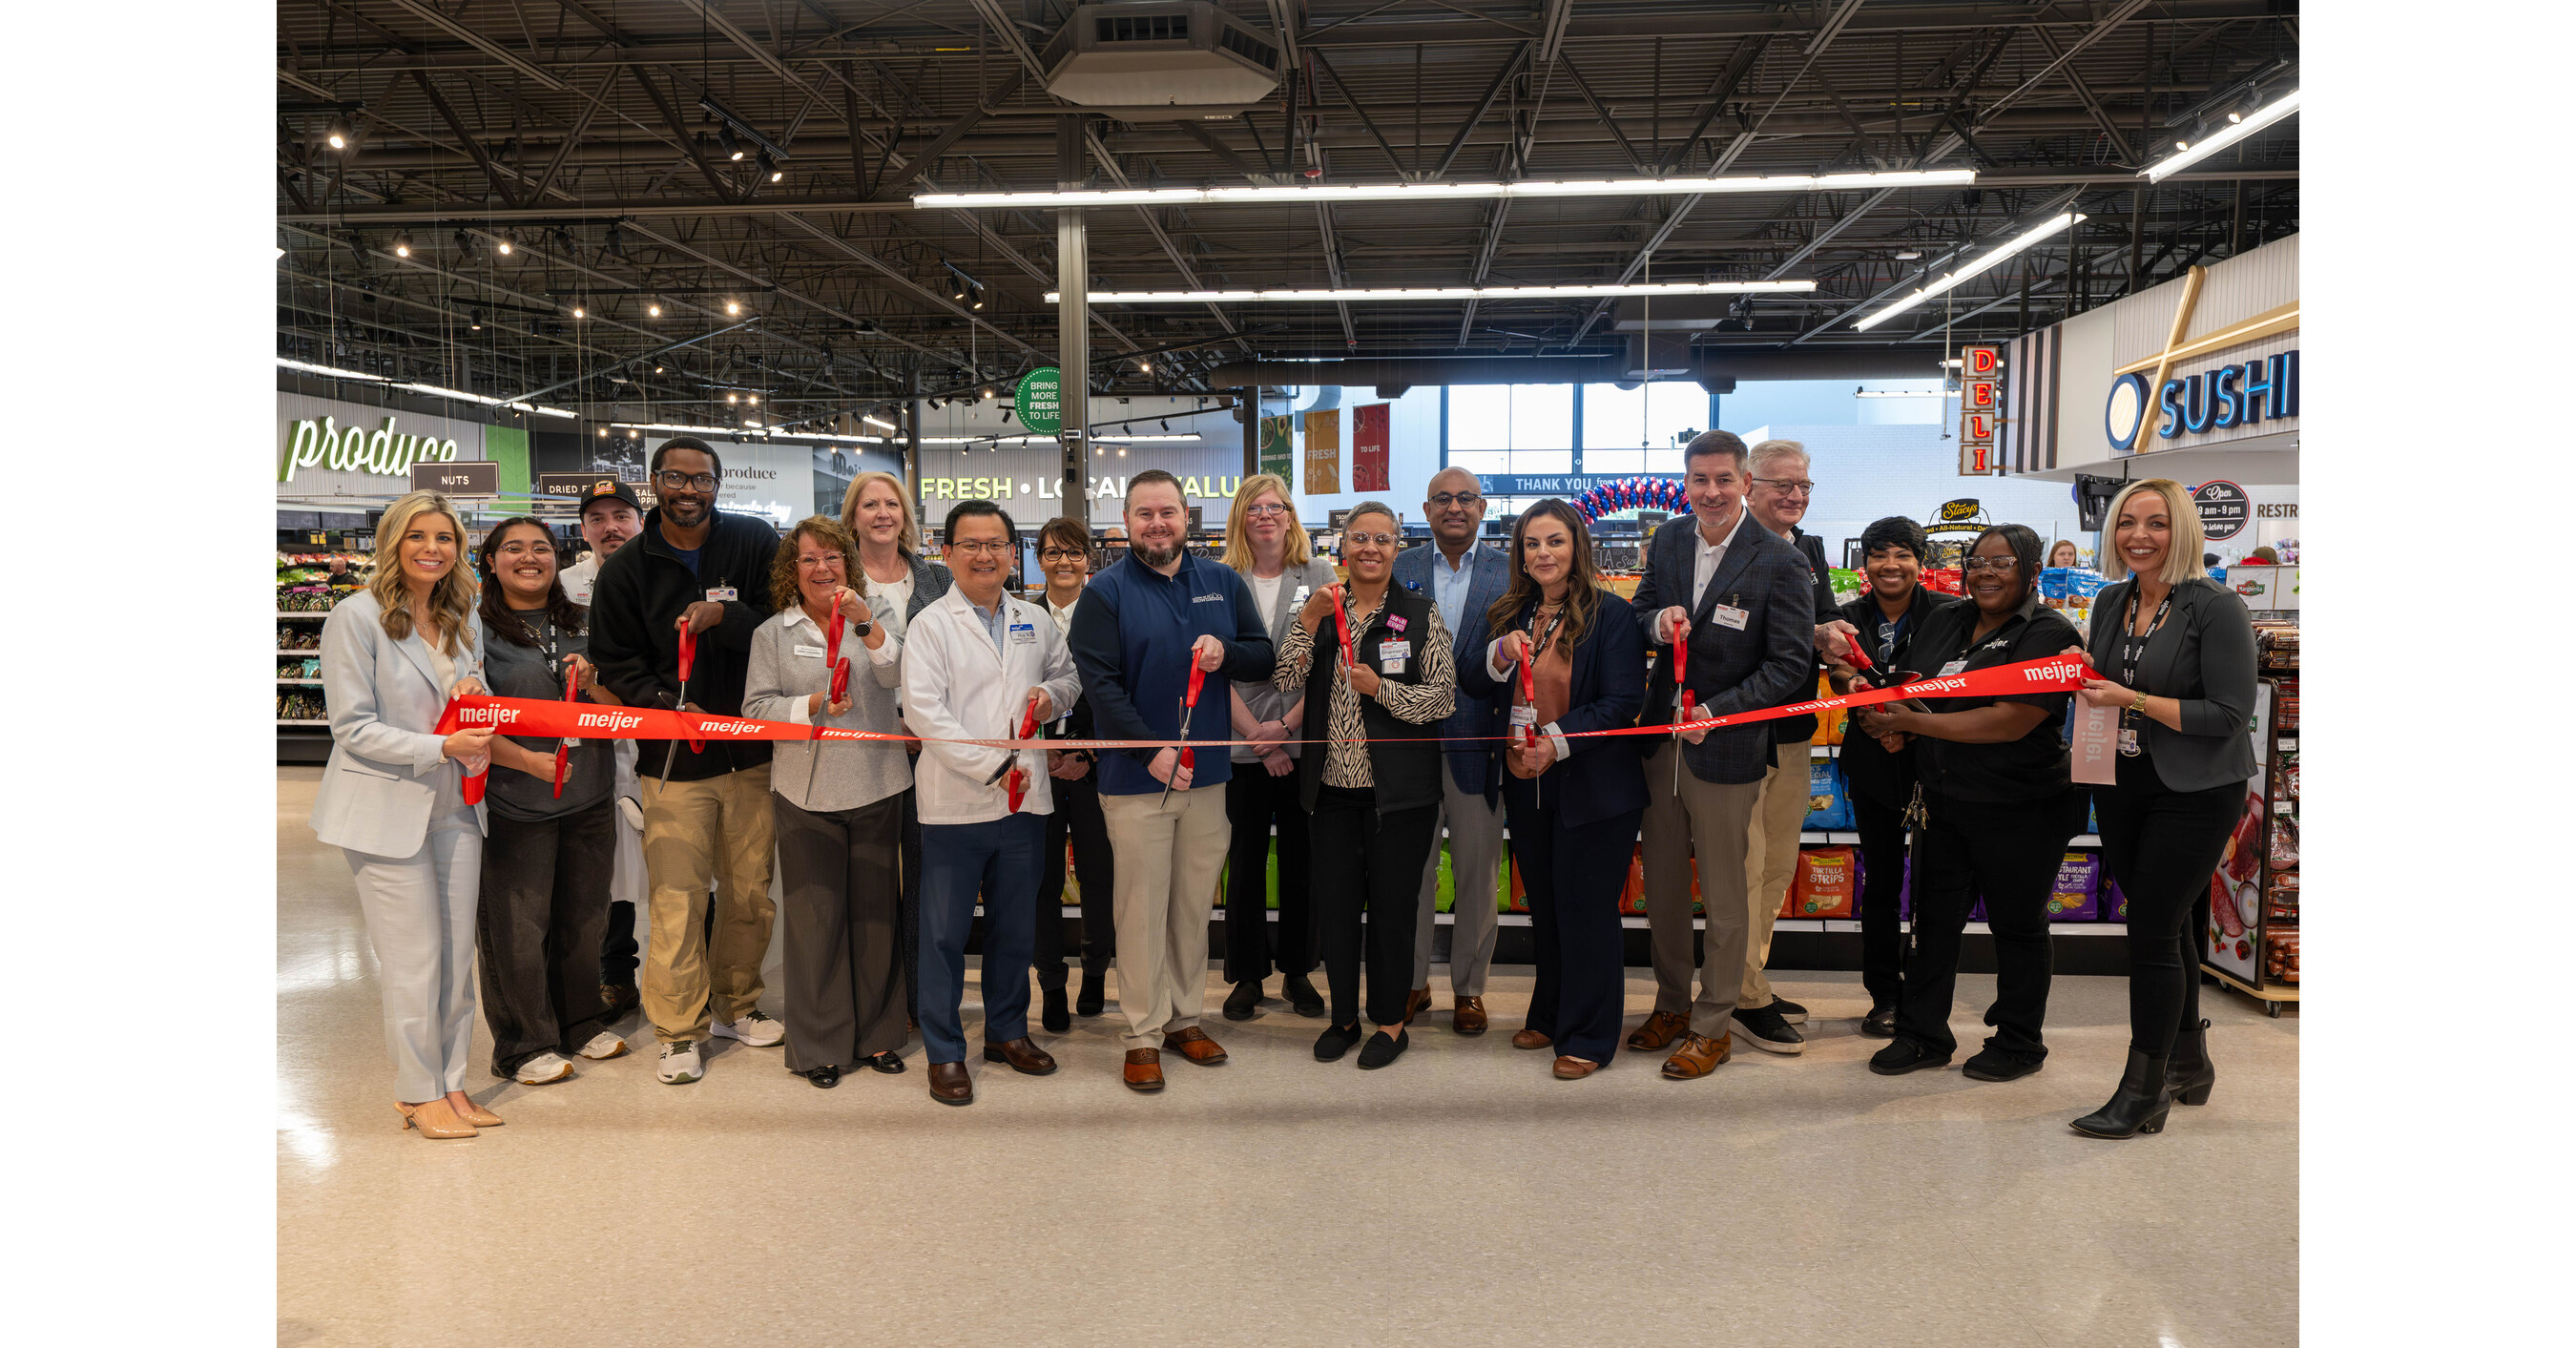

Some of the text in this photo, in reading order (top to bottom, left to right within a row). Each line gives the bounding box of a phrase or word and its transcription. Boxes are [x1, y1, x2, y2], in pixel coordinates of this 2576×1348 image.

[1030, 382, 1058, 390] BRING
[2159, 350, 2299, 439] SUSHI
[1029, 402, 1059, 410] FRESH
[1972, 349, 1995, 470] DELI
[1042, 411, 1060, 420] LIFE
[280, 415, 458, 482] produce
[1307, 447, 1337, 460] FRESH
[441, 475, 470, 486] NUTS
[719, 466, 778, 481] produce
[549, 485, 578, 494] DRIED
[921, 477, 1012, 500] FRESH
[1515, 478, 1561, 490] THANK
[1565, 478, 1591, 490] YOU
[2206, 485, 2233, 501] Open
[1942, 502, 1979, 520] Stacy's
[2197, 506, 2203, 515] 9
[2229, 506, 2241, 516] pm
[2257, 504, 2298, 518] RESTR
[2224, 523, 2235, 533] you
[1719, 613, 1740, 624] Thomas
[2024, 661, 2084, 684] meijer
[1904, 676, 1968, 694] meijer
[1785, 697, 1848, 713] meijer
[459, 703, 521, 727] meijer
[577, 711, 643, 732] meijer
[698, 720, 765, 736] meijer
[1668, 717, 1728, 732] meijer
[821, 729, 886, 739] meijer
[1812, 866, 1843, 875] TORTILLA
